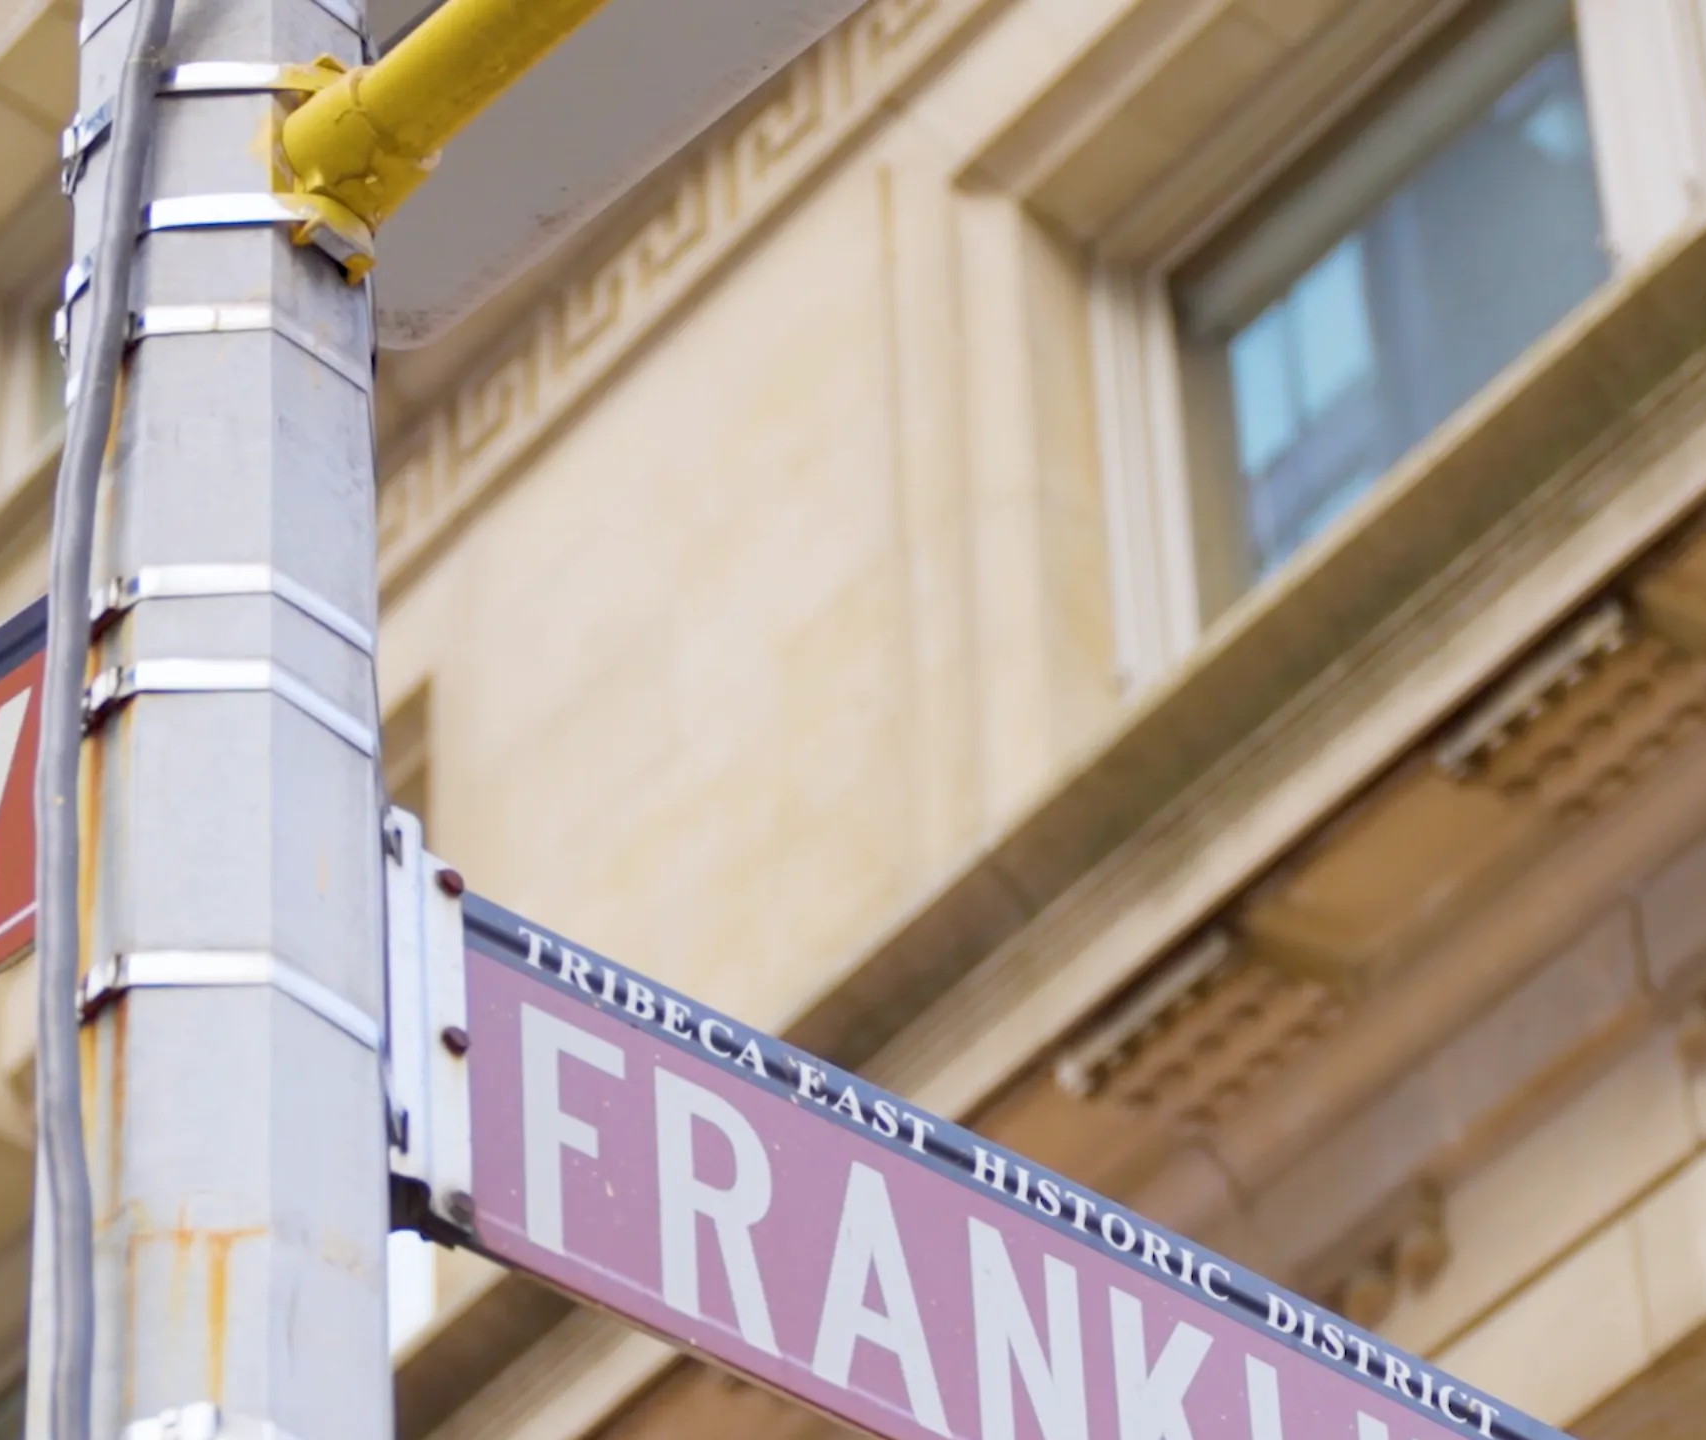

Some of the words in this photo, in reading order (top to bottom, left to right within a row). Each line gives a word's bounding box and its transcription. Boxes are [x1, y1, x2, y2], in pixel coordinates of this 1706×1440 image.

[518, 926, 773, 1079] TRIBECA
[796, 1058, 935, 1154] EAST
[971, 1144, 1232, 1302] HISTORIC
[1265, 1292, 1501, 1439] DISTRICT
